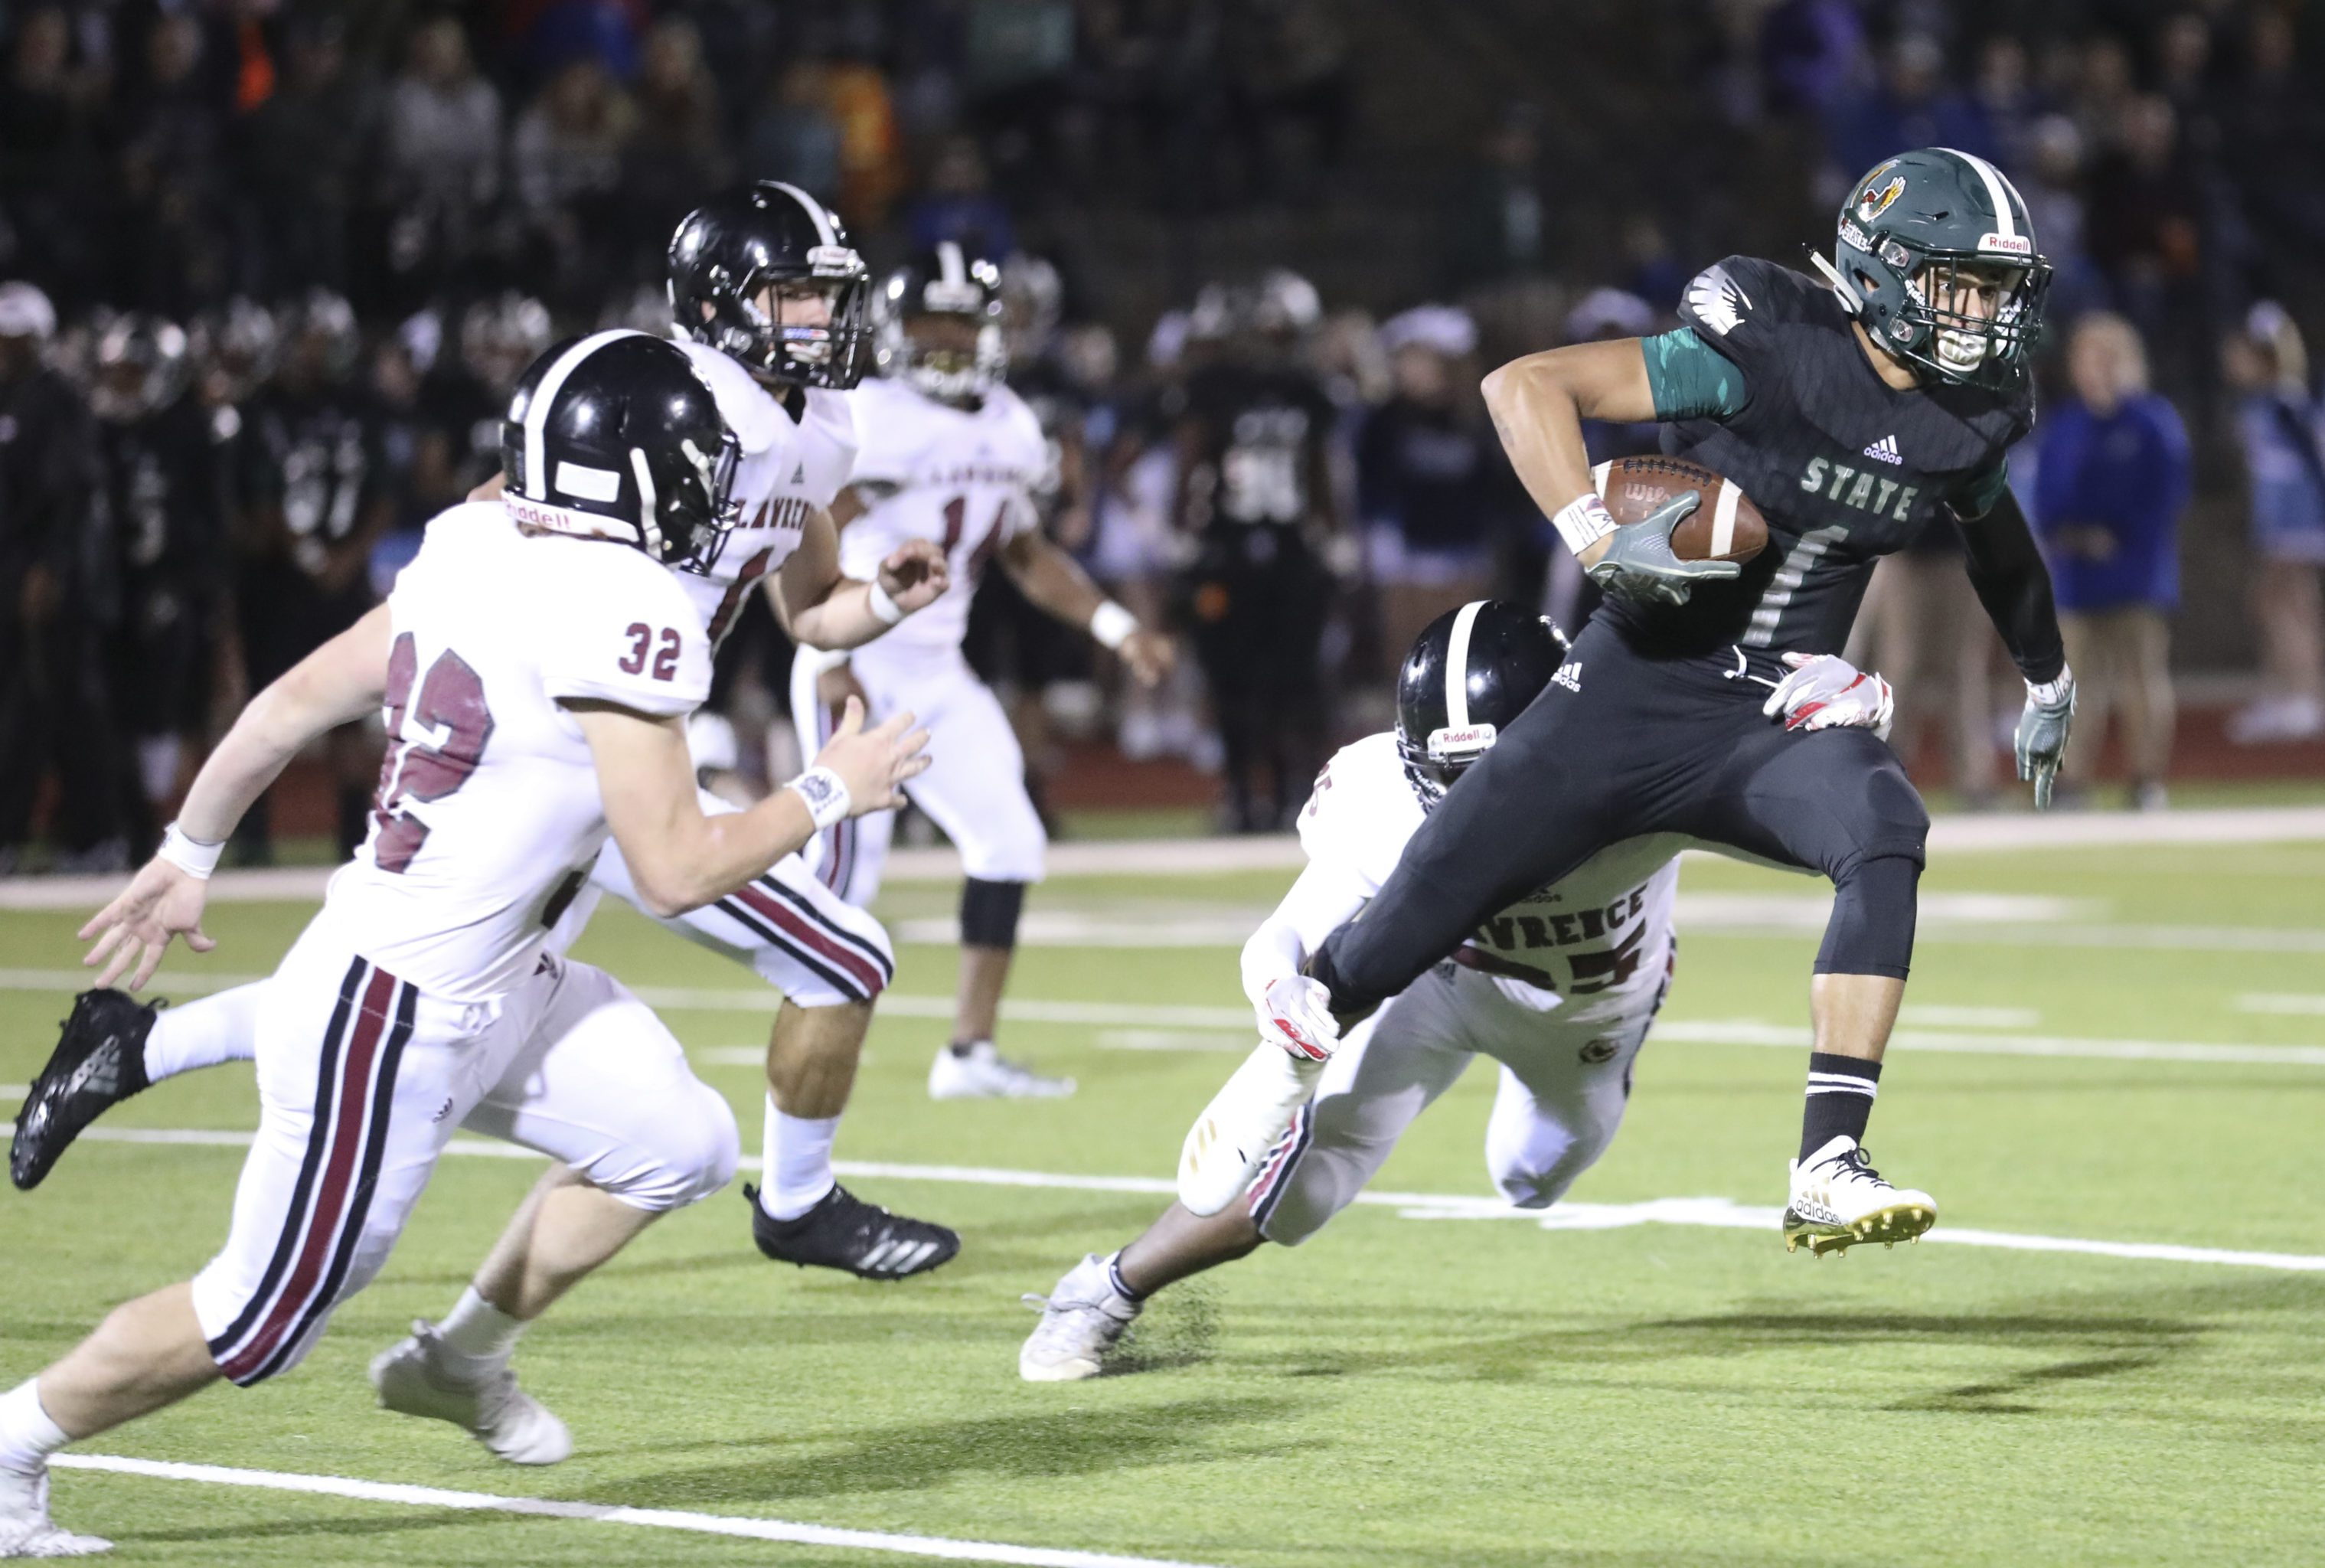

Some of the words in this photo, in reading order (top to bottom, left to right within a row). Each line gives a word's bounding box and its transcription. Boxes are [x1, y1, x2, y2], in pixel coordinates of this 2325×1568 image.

[1989, 237, 2029, 252] Riddell
[1863, 446, 1903, 466] adidas
[1800, 456, 1918, 522] STATE
[619, 622, 681, 682] 32
[1443, 729, 1481, 743] Riddell
[1796, 1200, 1842, 1224] adidas
